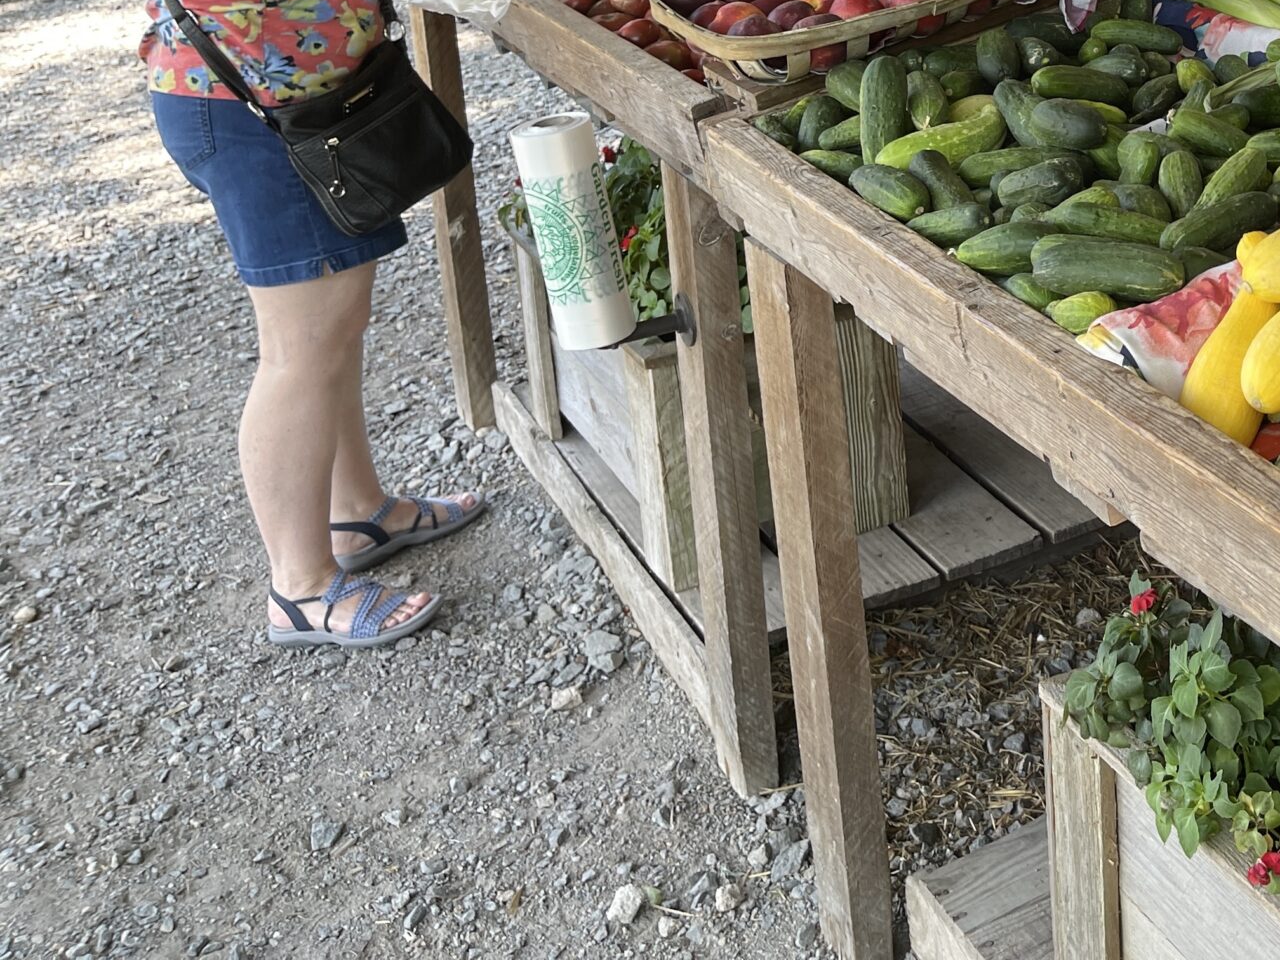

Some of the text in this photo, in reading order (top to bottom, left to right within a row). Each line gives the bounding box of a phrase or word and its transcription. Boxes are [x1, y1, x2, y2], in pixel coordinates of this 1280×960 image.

[544, 203, 567, 224] fruits
[591, 162, 612, 235] Garden
[608, 238, 625, 293] Fresh
